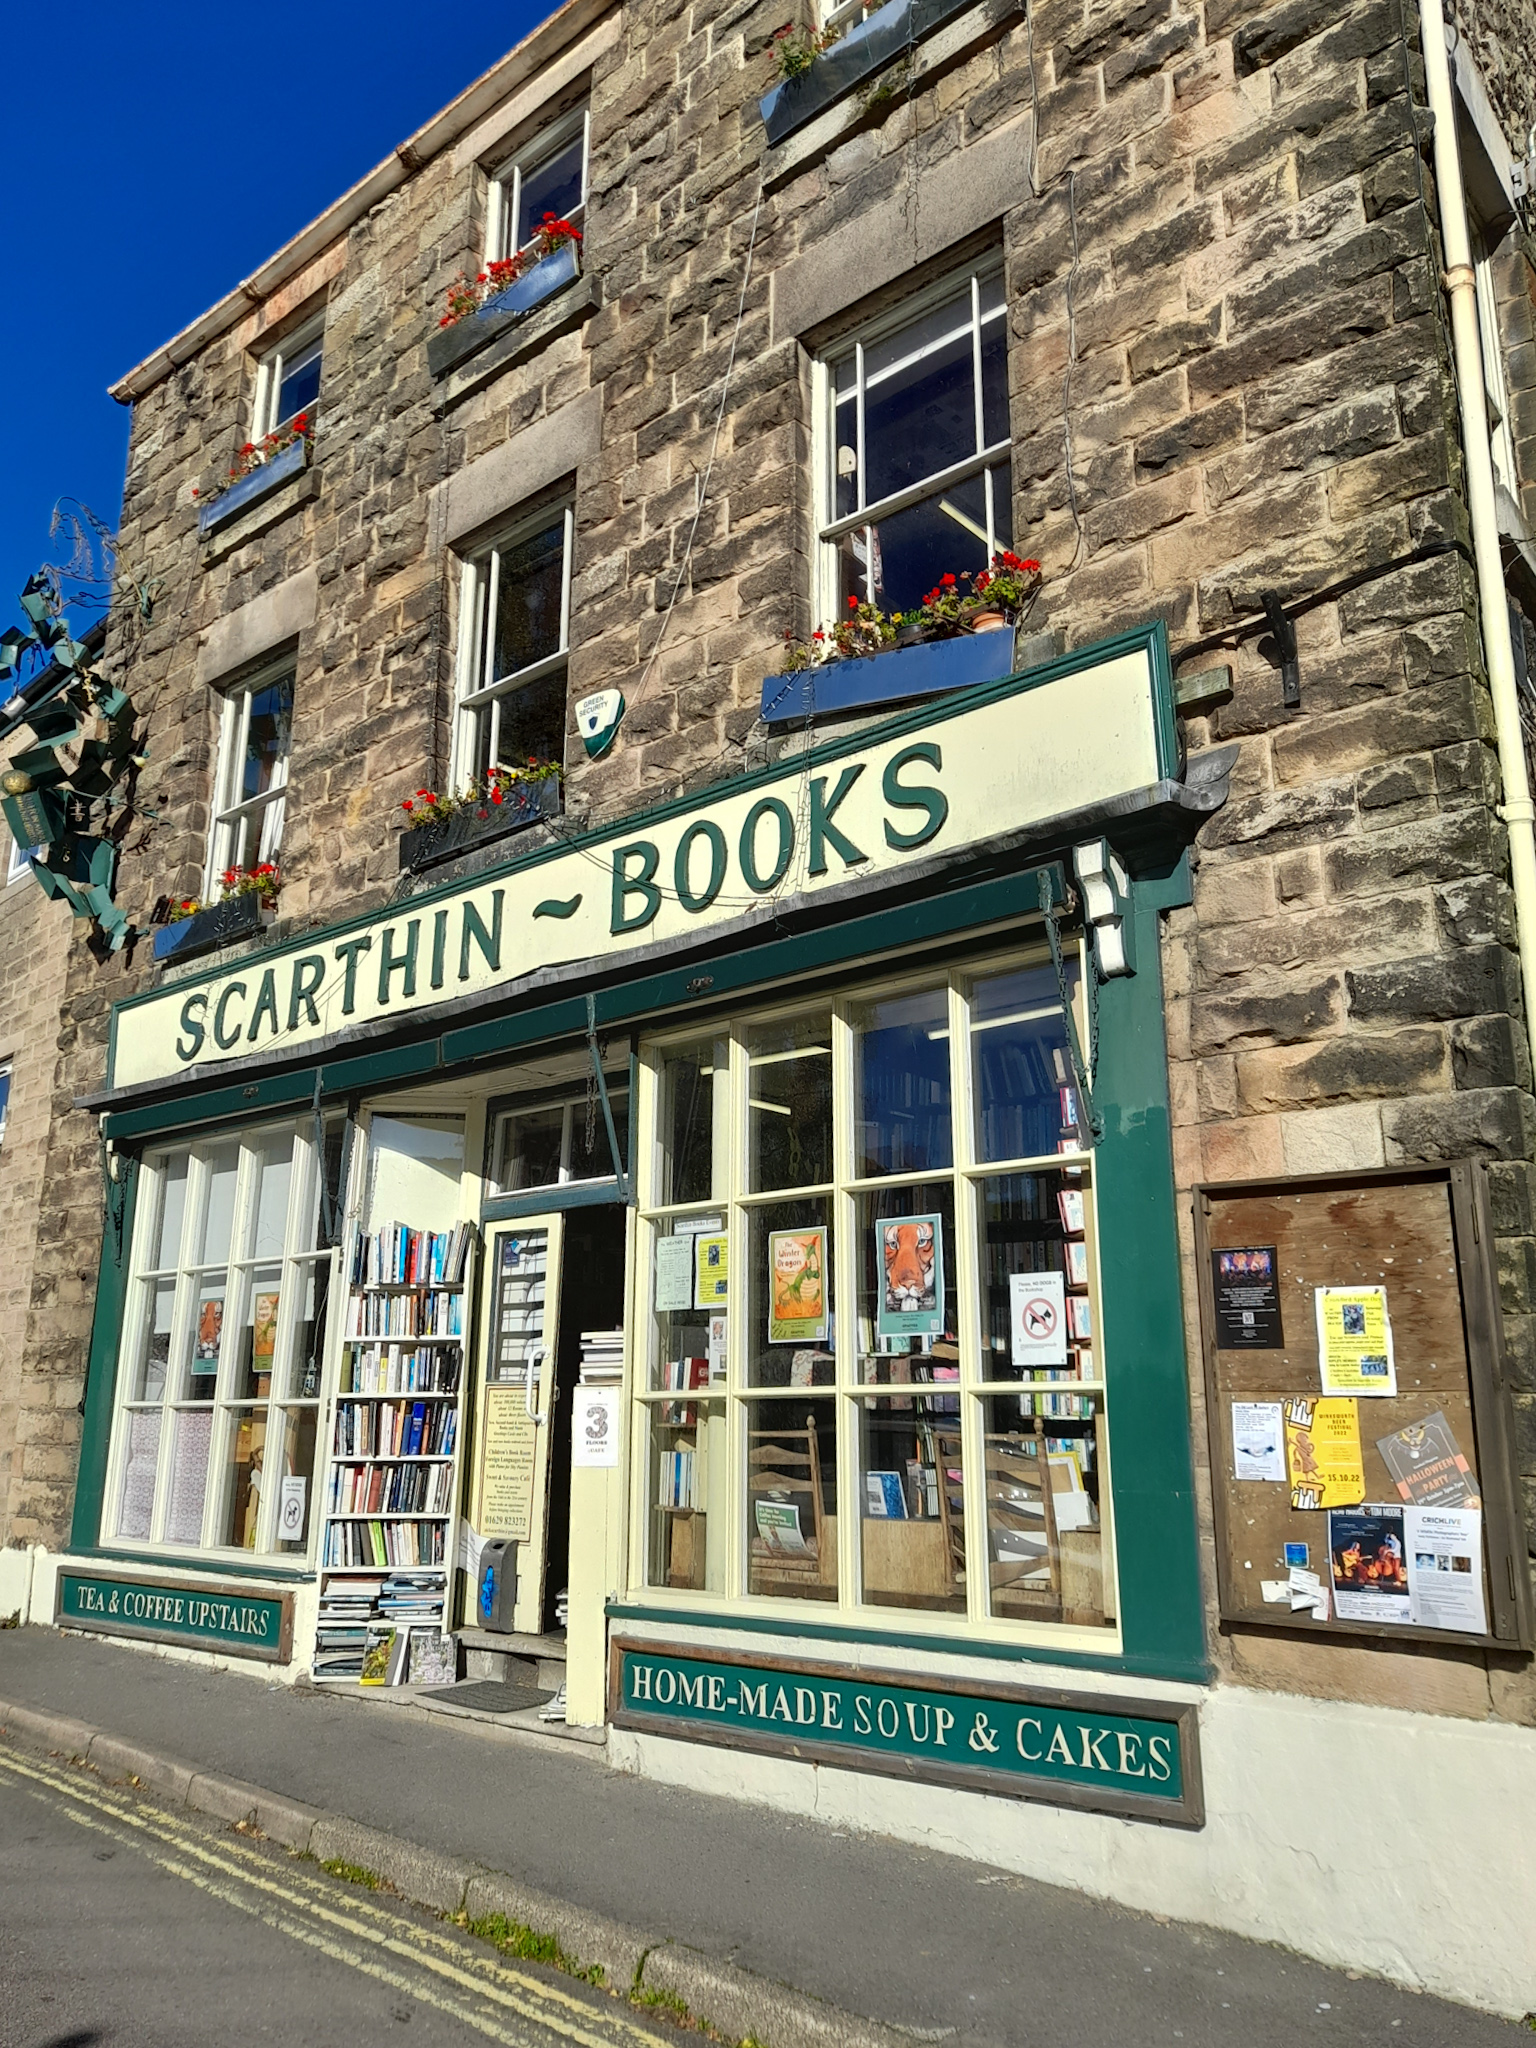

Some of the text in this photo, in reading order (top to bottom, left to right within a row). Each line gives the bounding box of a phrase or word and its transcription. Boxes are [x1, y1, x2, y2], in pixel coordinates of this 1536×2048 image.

[583, 695, 605, 708] GREEN
[579, 700, 609, 717] SECURITY
[176, 889, 505, 1061] SCARTHIN
[610, 742, 949, 937] BOOKS
[778, 1249, 800, 1258] Winter
[777, 1260, 802, 1269] Dragon
[585, 1406, 609, 1439] 3
[488, 1448, 508, 1456] Children's
[1405, 1456, 1455, 1486] HALLOWEEN
[1328, 1474, 1360, 1482] 15.10.22
[1422, 1473, 1449, 1493] PARTY
[1370, 1507, 1382, 1516] TOM
[1383, 1507, 1402, 1517] MOORE
[484, 1514, 526, 1527] 01629 823272
[1421, 1516, 1461, 1526] CRICHLIVE
[78, 1586, 270, 1637] TEA & COFFEE UPSTAIRS
[631, 1665, 1171, 1781] HOME-MADE SOUP & CAKES
